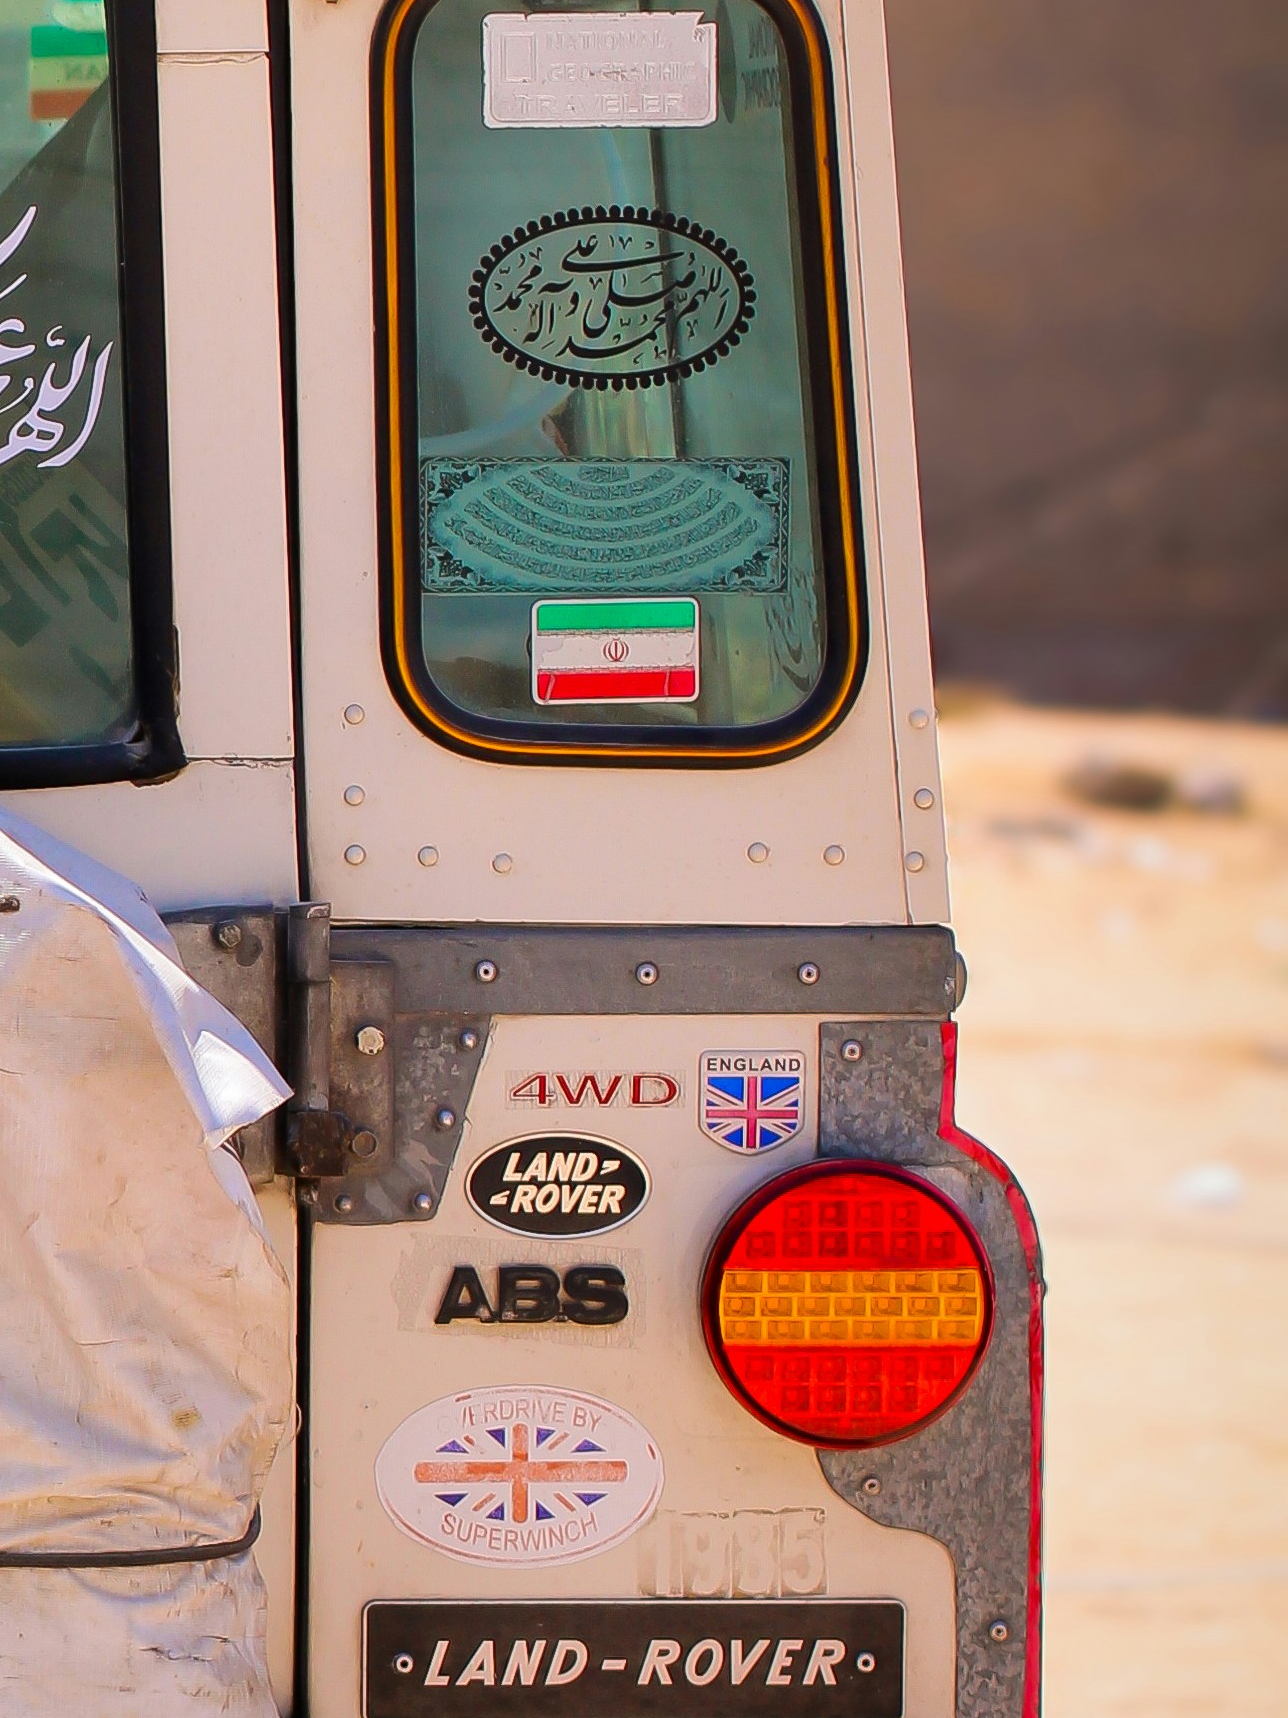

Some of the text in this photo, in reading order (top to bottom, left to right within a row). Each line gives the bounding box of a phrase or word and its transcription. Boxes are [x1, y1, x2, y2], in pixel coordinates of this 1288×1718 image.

[544, 31, 666, 50] NATIONAL
[545, 62, 697, 82] GEOGRAPHIC
[706, 1057, 802, 1073] ENGLAND
[510, 1073, 681, 1107] 4WD
[502, 1151, 597, 1182] LAND
[510, 1184, 626, 1215] ROVER
[434, 1264, 630, 1326] ABS
[573, 1400, 603, 1433] BY
[440, 1512, 599, 1552] SUPERWINCH
[424, 1638, 847, 1687] LAND-ROVER
